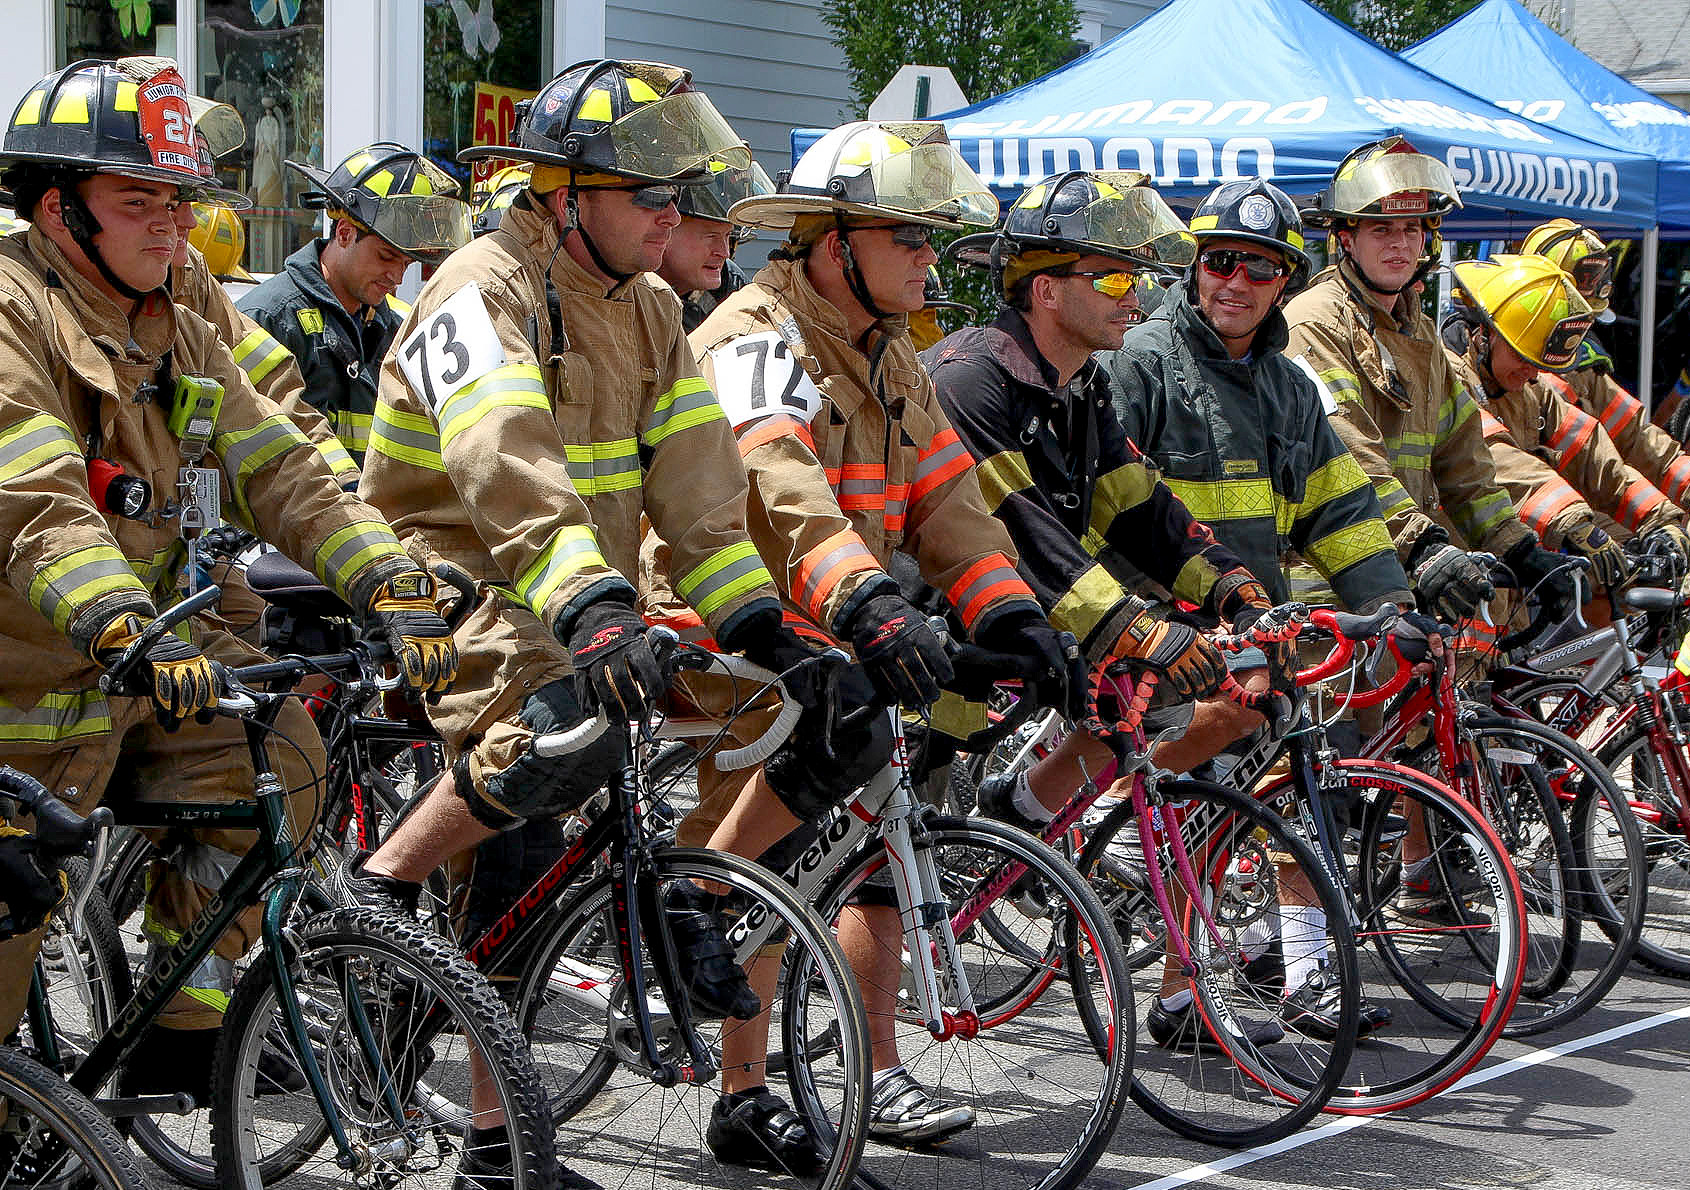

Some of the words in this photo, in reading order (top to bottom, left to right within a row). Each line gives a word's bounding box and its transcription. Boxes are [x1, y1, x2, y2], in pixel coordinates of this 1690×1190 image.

[147, 84, 175, 101] JUNIOR
[163, 109, 194, 147] 27
[159, 152, 180, 165] FIRE
[1446, 145, 1620, 213] SHIMANO
[405, 312, 470, 410] 73
[736, 340, 808, 412] 72
[887, 817, 901, 834] 3T
[1477, 847, 1505, 901] VICTORY
